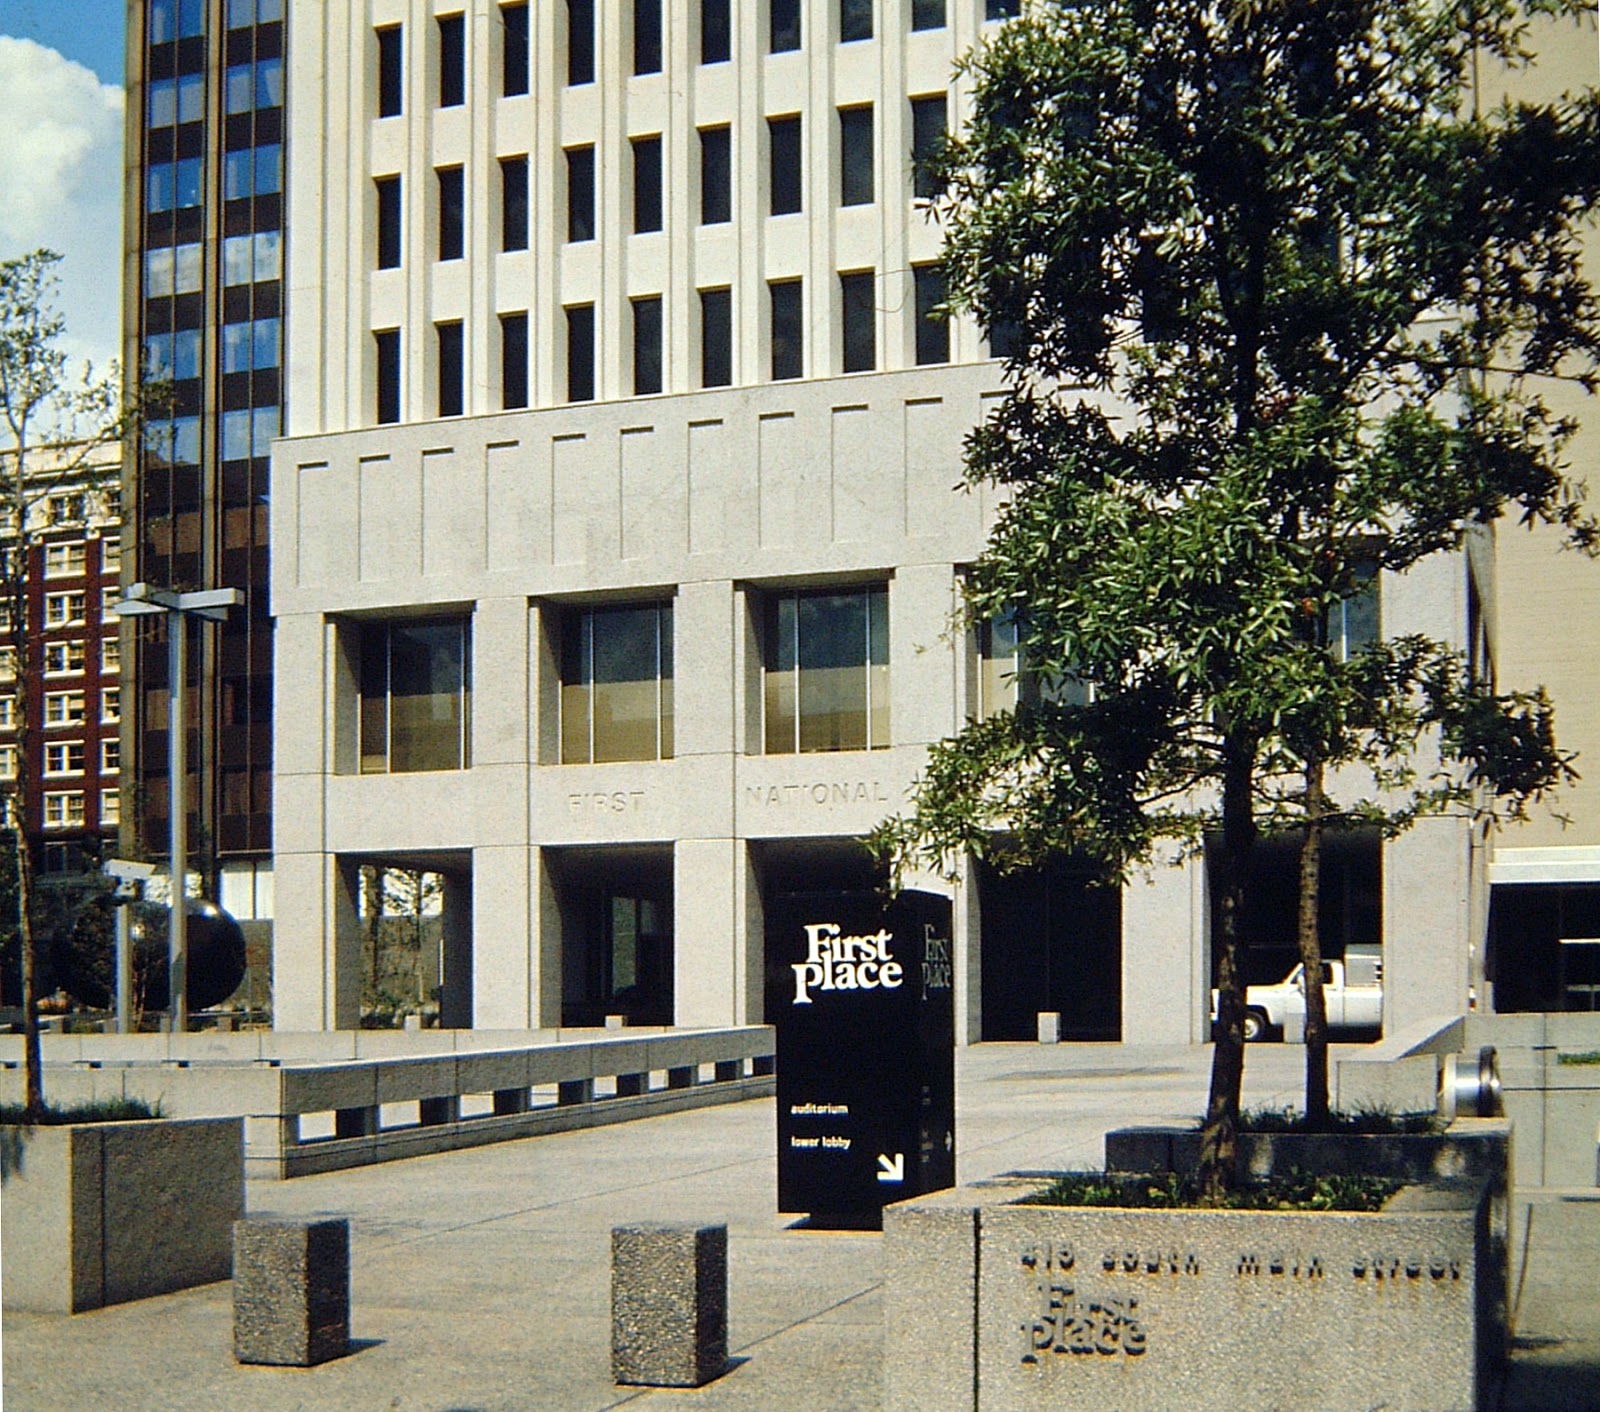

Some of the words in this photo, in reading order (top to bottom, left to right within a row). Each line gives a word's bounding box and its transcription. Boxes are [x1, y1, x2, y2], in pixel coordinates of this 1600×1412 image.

[568, 790, 646, 813] FIRST
[746, 781, 889, 808] NATIONAL
[803, 923, 894, 963] First
[791, 949, 904, 1005] place
[791, 1102, 849, 1115] auditorium
[791, 1135, 820, 1148] lower
[822, 1135, 851, 1150] lobby
